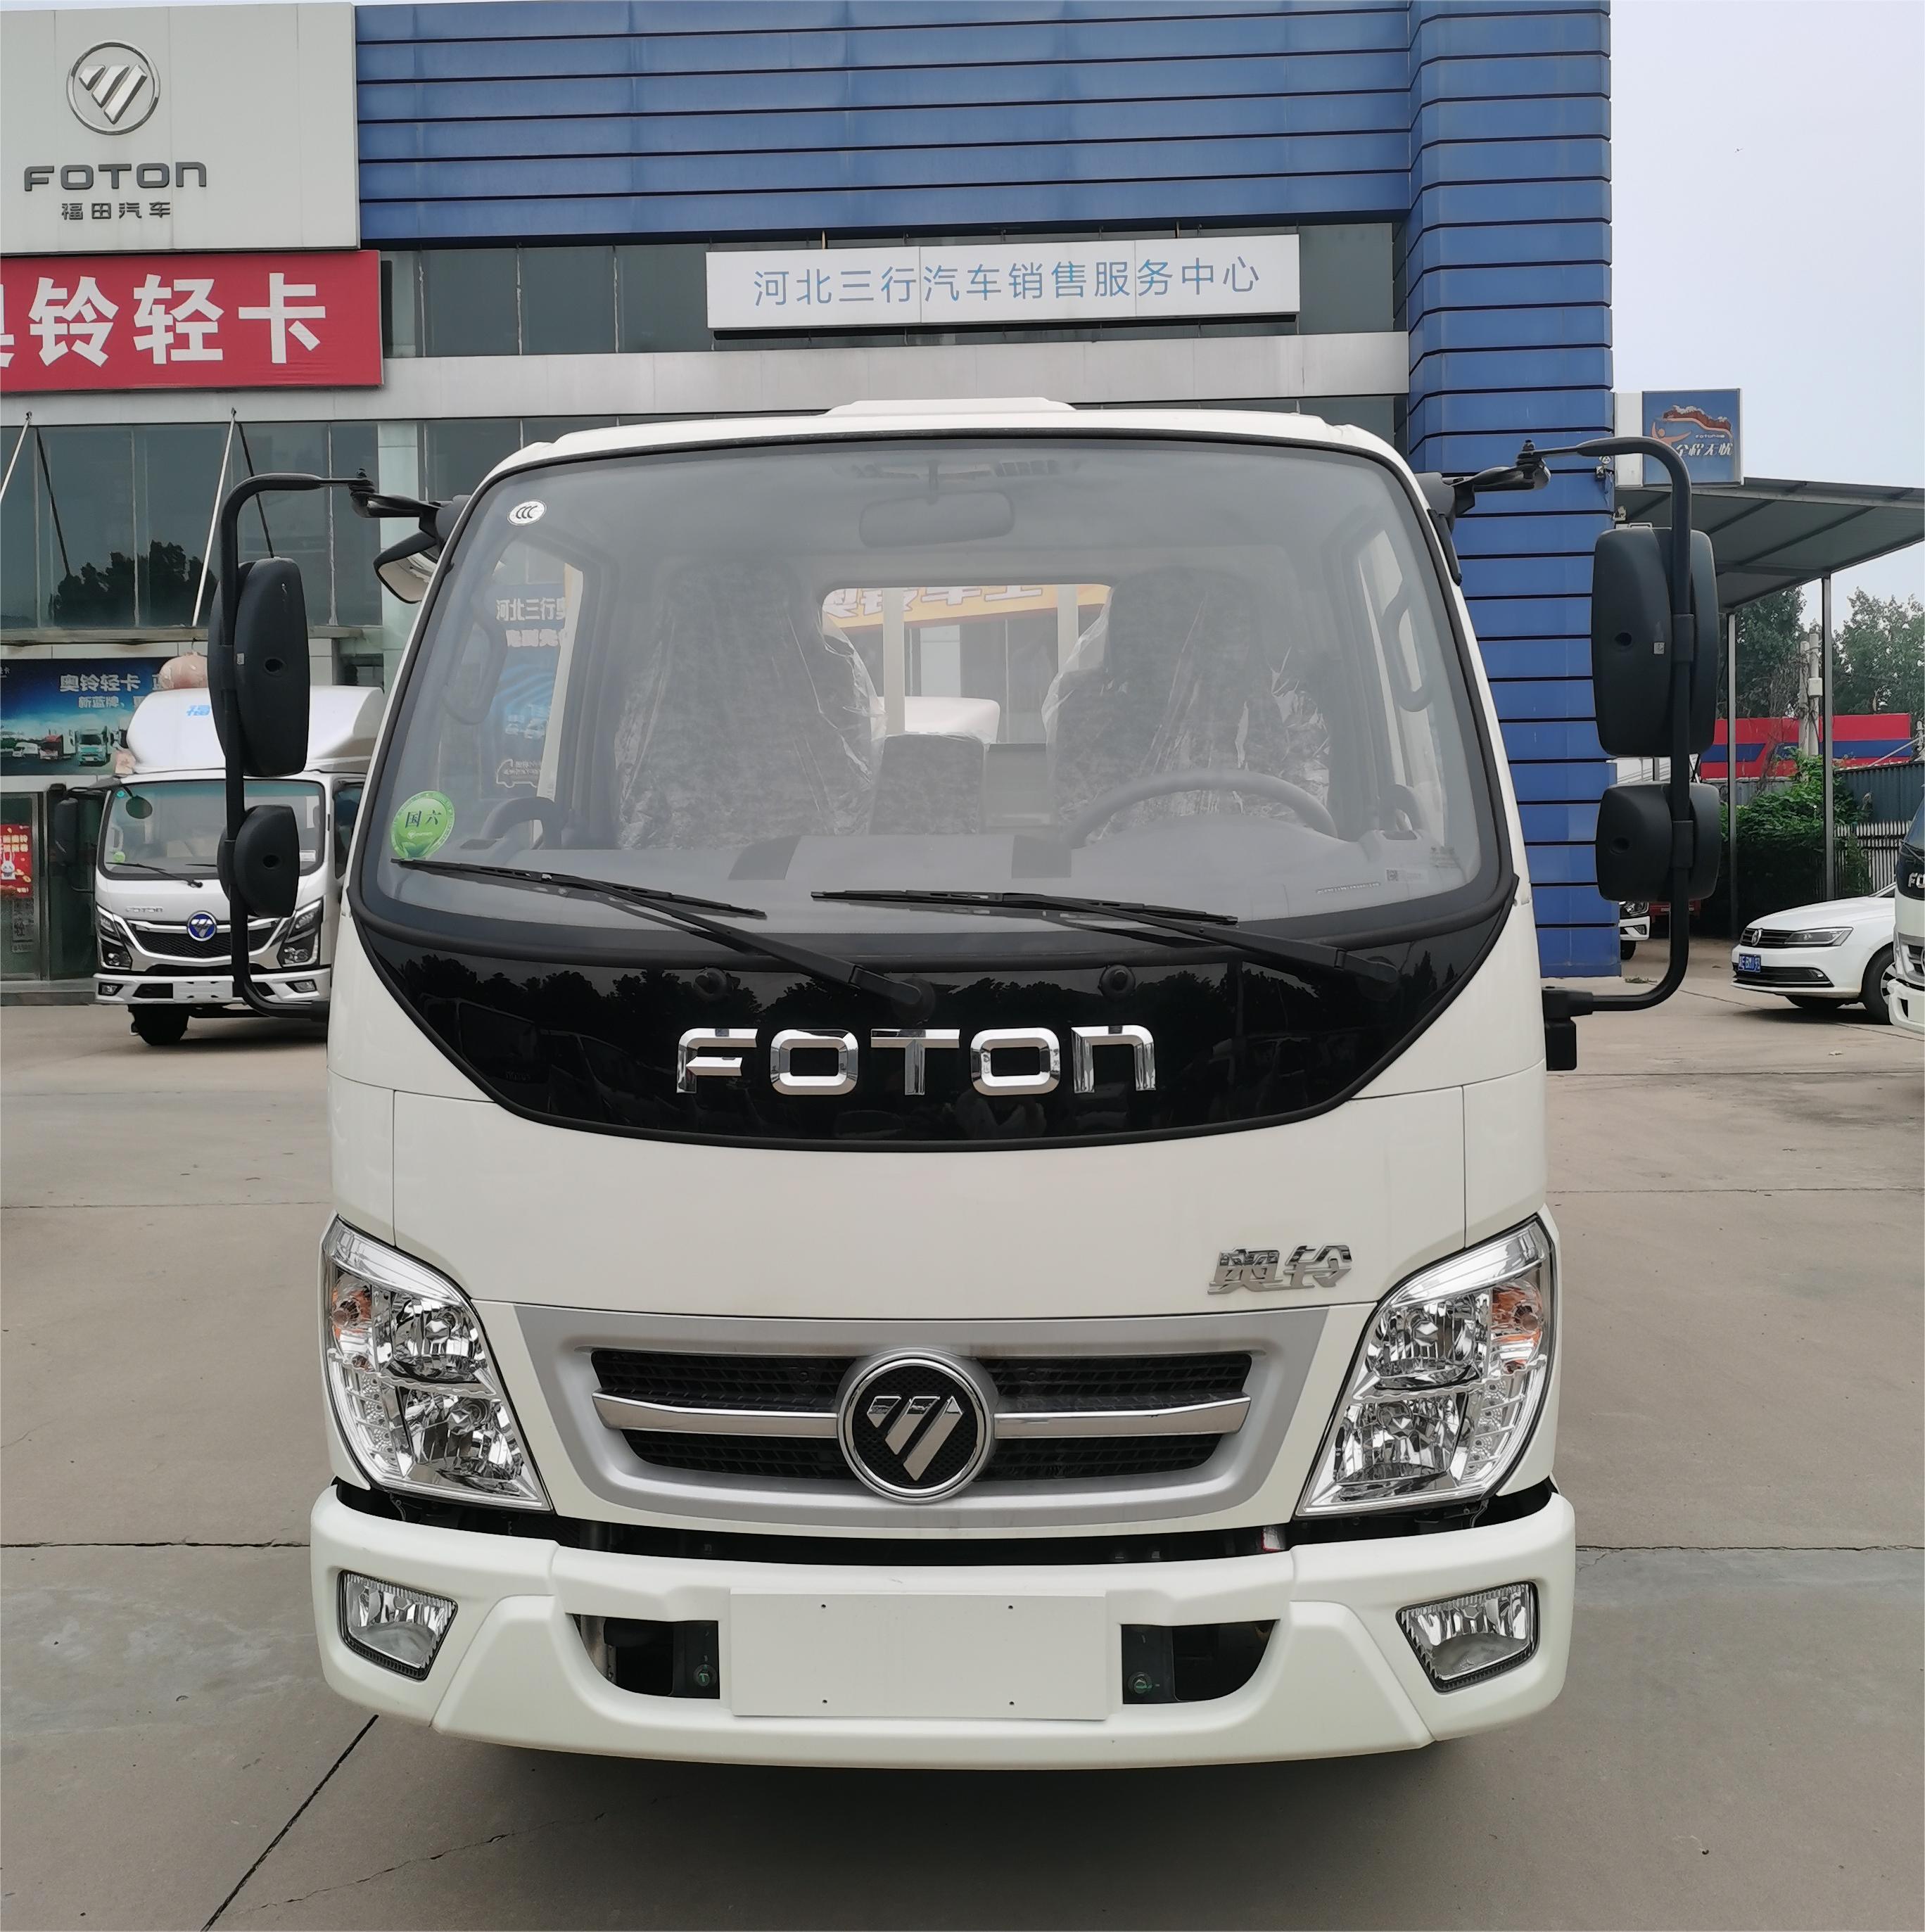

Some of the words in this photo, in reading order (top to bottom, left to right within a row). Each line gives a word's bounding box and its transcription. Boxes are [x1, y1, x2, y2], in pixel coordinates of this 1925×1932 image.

[24, 161, 207, 192] FOTON
[61, 201, 171, 220] 福田汽车
[754, 256, 1260, 306] 河北三行汽车销售服务中心
[0, 272, 326, 367] 铃轻卡
[59, 673, 141, 693] 奥铃轻卡
[405, 810, 442, 829] 国六
[675, 1024, 1157, 1095] FOTON
[1207, 1243, 1352, 1295] 奥铃
